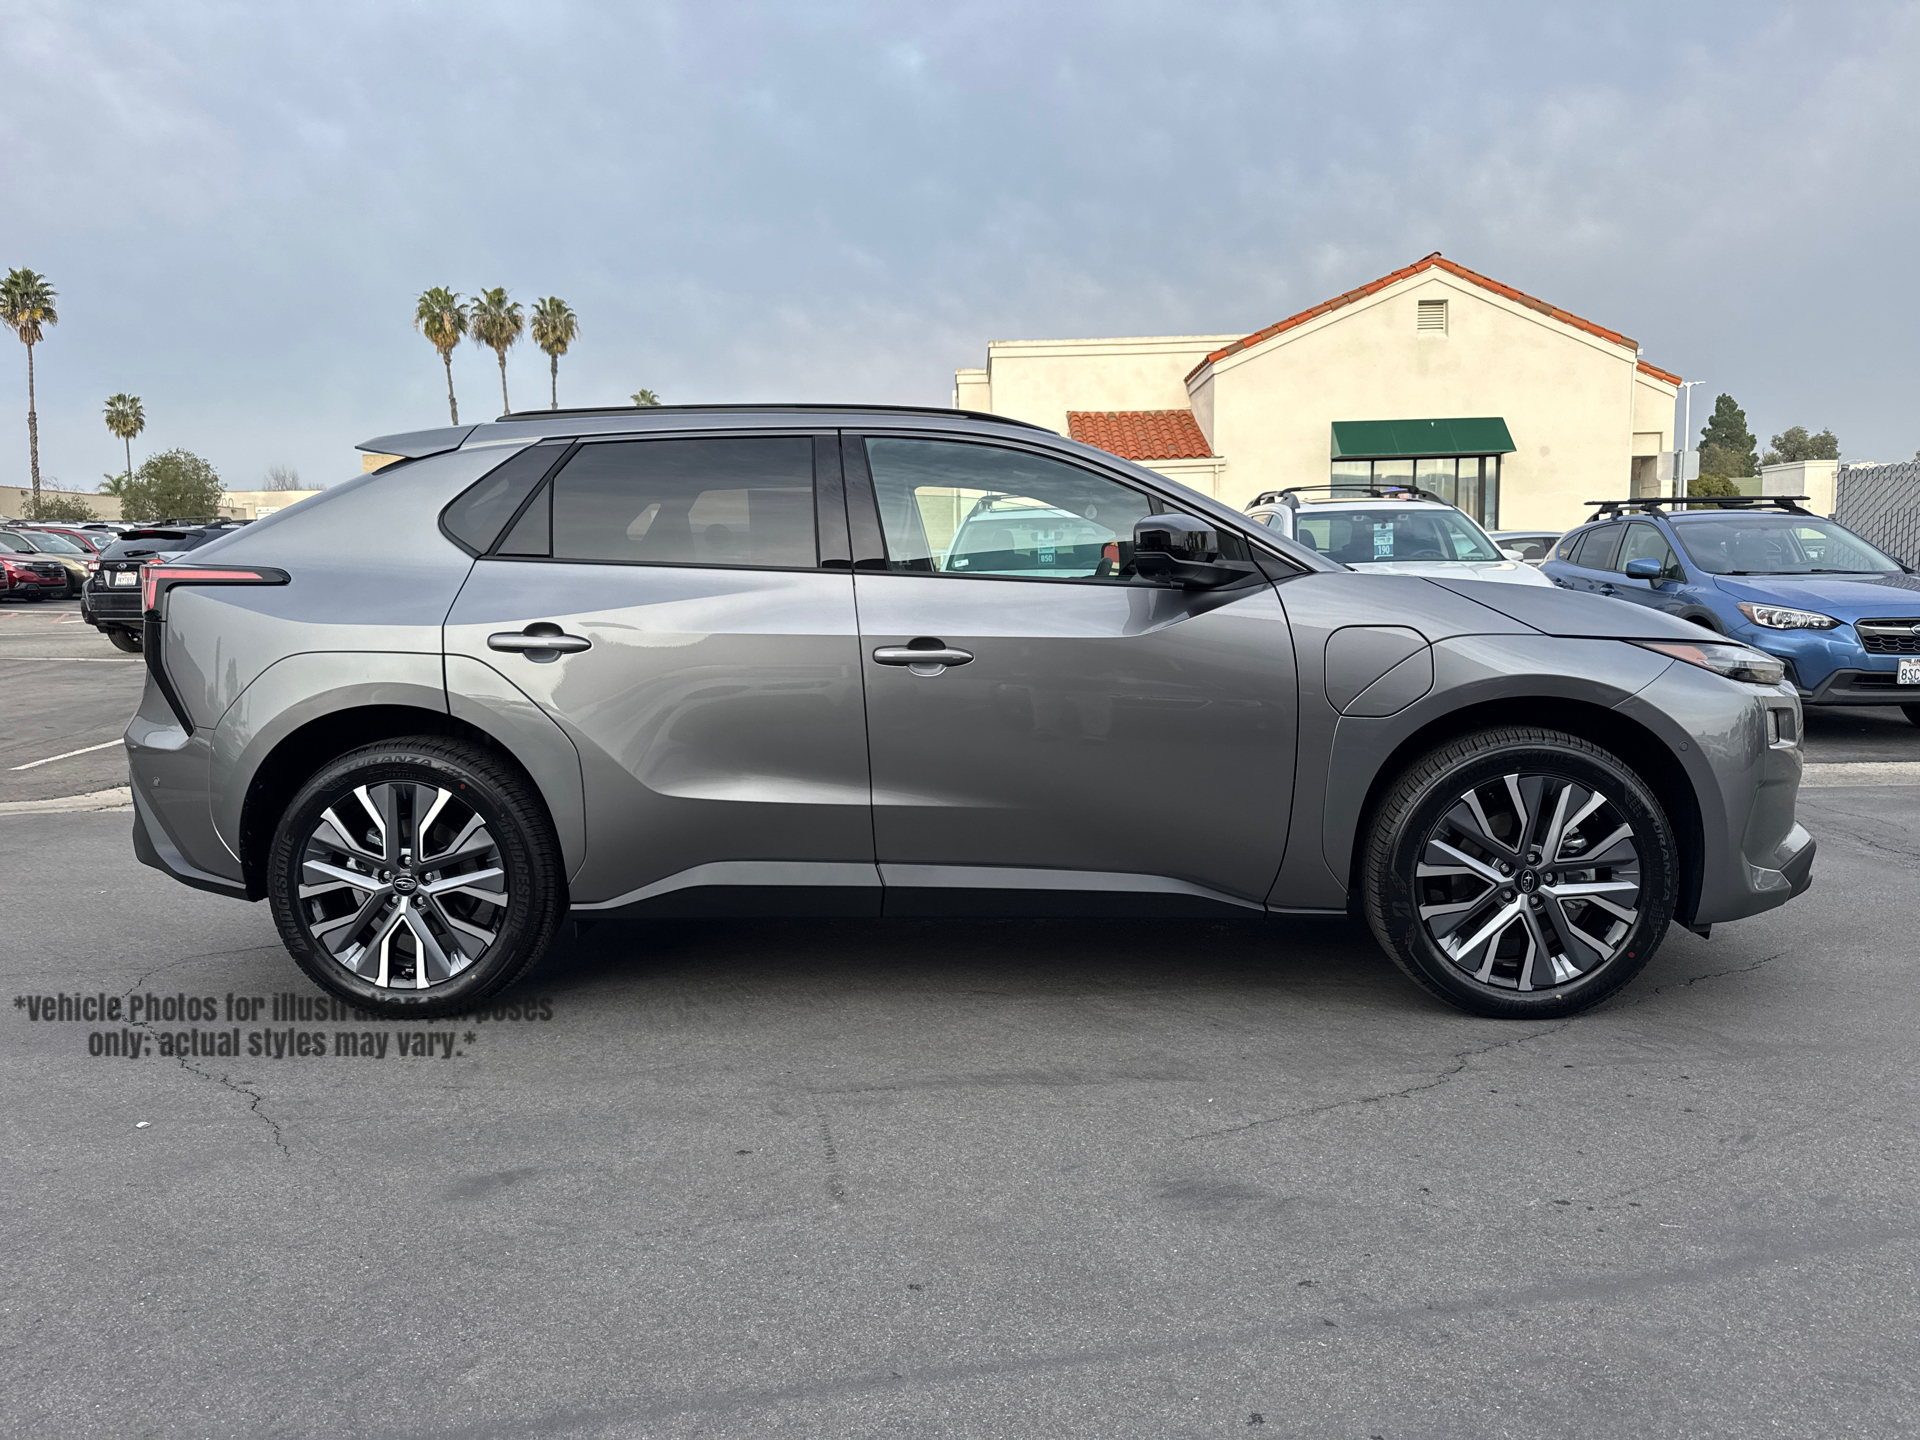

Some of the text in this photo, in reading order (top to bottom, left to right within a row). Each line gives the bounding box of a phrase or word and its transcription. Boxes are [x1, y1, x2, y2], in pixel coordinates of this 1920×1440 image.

[1041, 554, 1053, 563] 850
[1377, 545, 1390, 555] 190
[1900, 668, 1920, 681] 8SC
[343, 755, 433, 772] TURANZA
[1646, 810, 1672, 902] TURANZA
[499, 816, 531, 938] BRIDGESTONE
[274, 831, 310, 953] BRIDGESTONE
